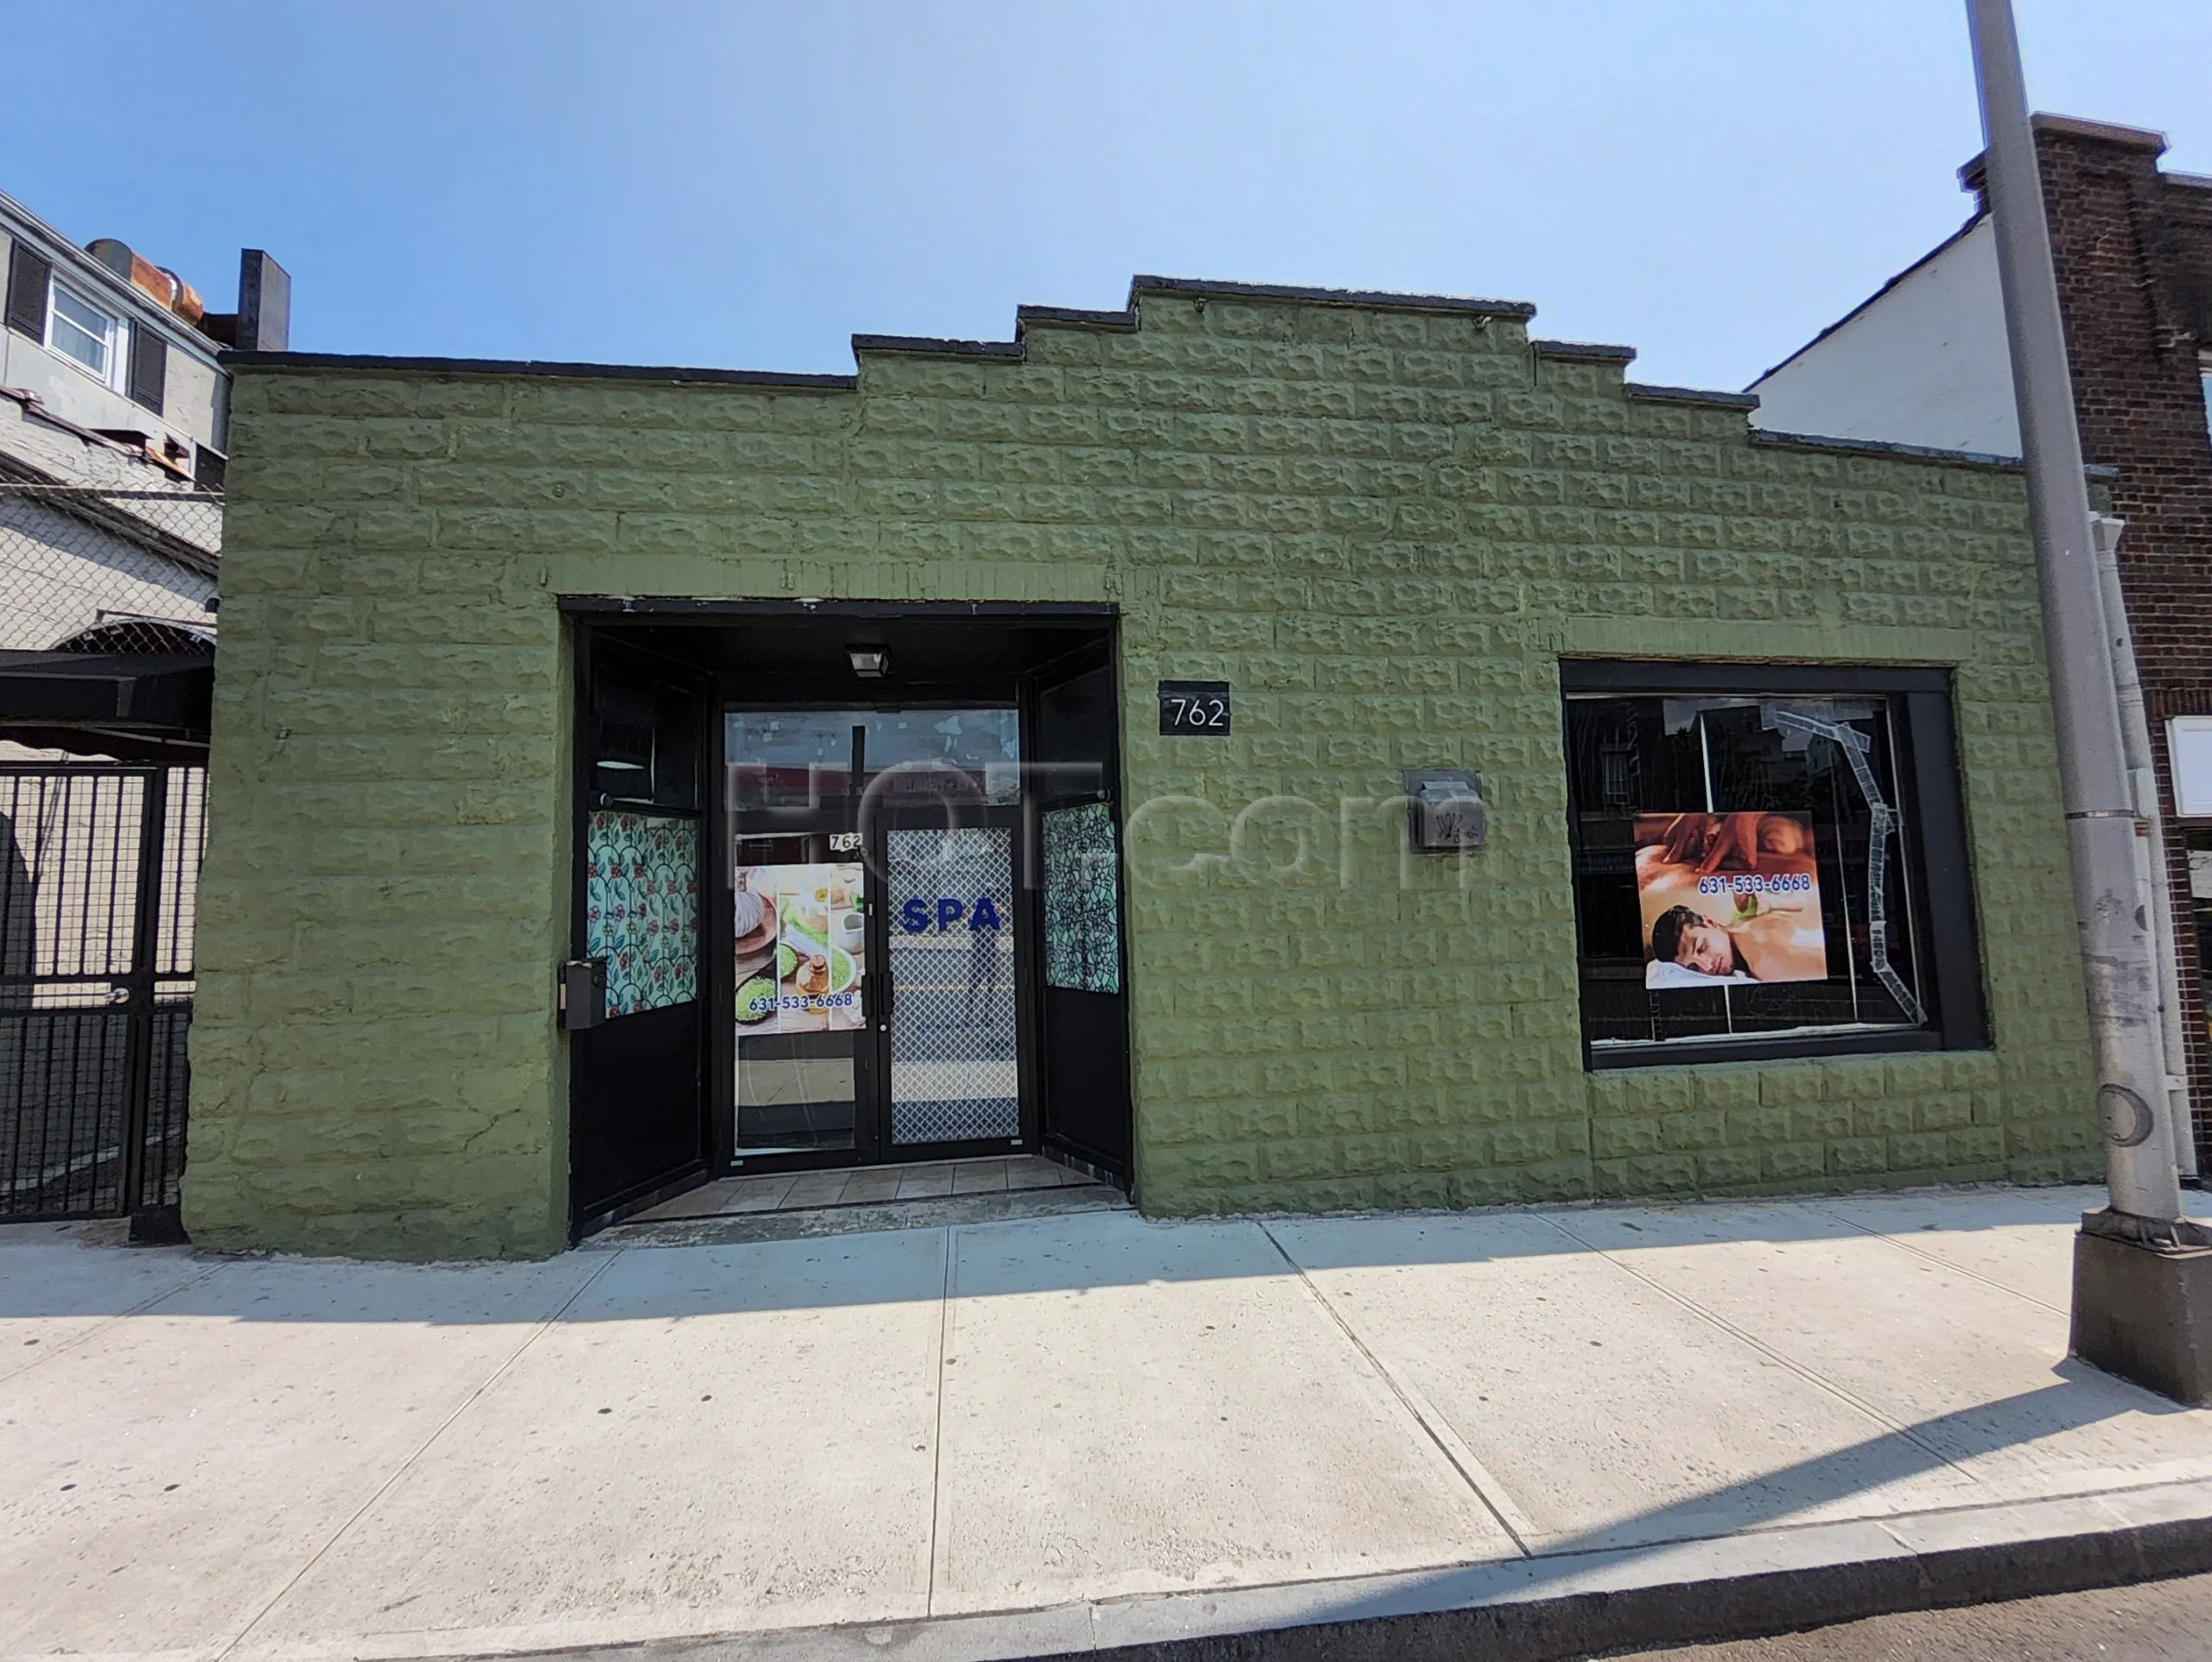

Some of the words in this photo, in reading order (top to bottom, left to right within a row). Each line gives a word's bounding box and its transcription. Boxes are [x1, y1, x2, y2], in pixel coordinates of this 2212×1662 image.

[1170, 699, 1224, 726] 762
[830, 835, 861, 849] 762
[1699, 873, 1811, 895] 631-533-6668
[902, 897, 1002, 933] SPA
[748, 993, 854, 1012] 631-533-6668
